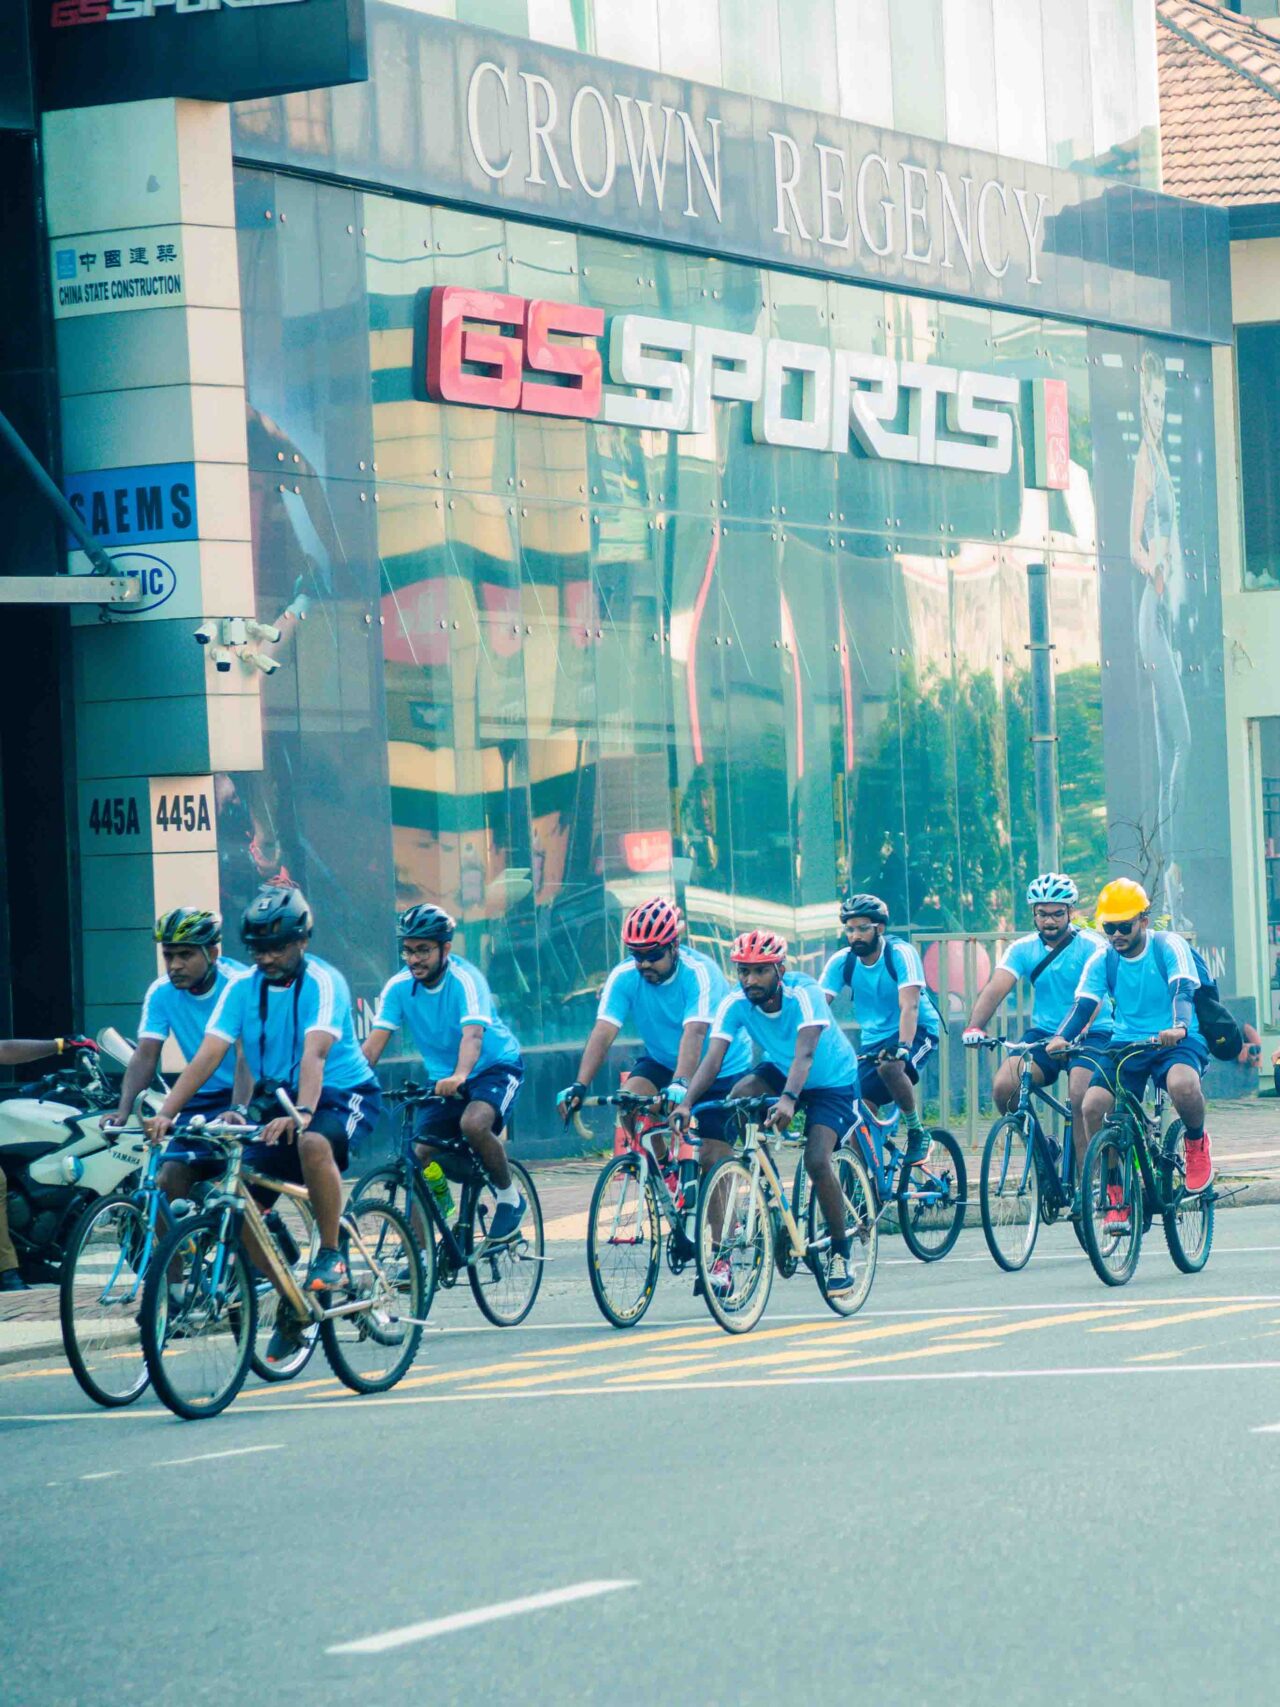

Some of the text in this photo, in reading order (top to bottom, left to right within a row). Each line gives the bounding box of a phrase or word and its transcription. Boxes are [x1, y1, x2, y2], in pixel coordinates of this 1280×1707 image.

[467, 61, 1048, 285] CROWN REGENCY
[59, 275, 181, 306] CHINA STATE CONSTRUCTION
[428, 285, 1019, 474] GS SPORTS
[89, 796, 141, 836] 445A
[156, 794, 211, 832] 445A
[112, 1151, 140, 1165] YAMAHA
